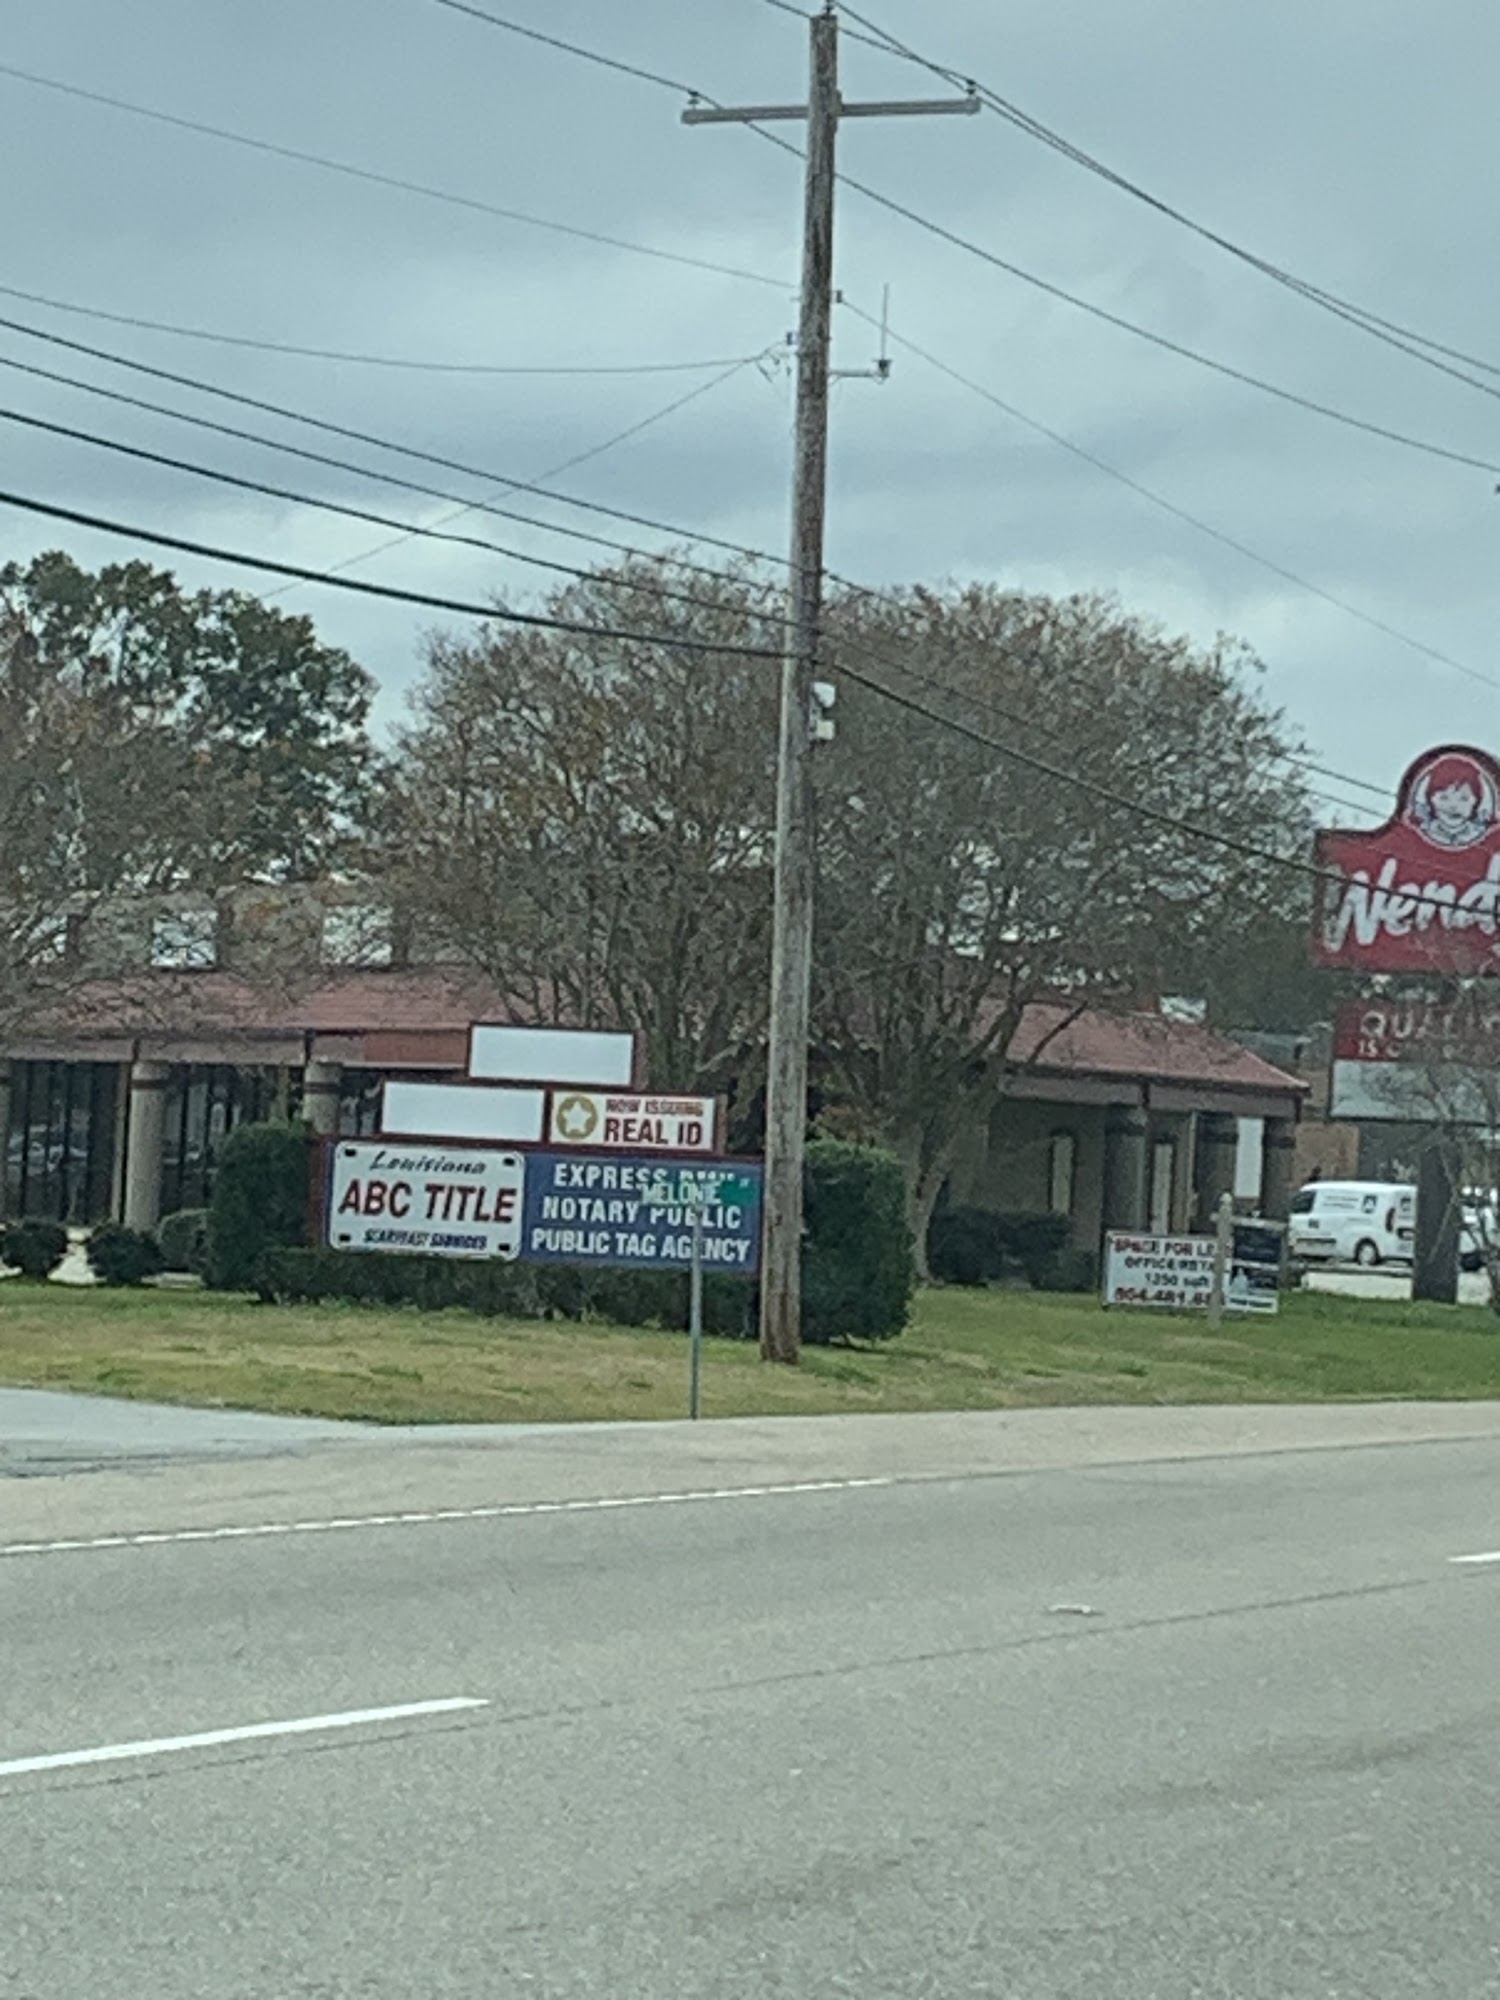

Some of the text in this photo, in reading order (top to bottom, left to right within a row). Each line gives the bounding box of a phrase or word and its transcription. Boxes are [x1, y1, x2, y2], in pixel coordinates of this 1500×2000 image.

[604, 1118, 702, 1146] REAL ID
[369, 1150, 487, 1175] Louisiana
[554, 1163, 668, 1190] EXPRESS
[338, 1178, 517, 1223] ABC TITLE
[542, 1195, 741, 1229] NOTARY PUBLIC
[531, 1227, 750, 1262] PUBLIC TAG AGNCY
